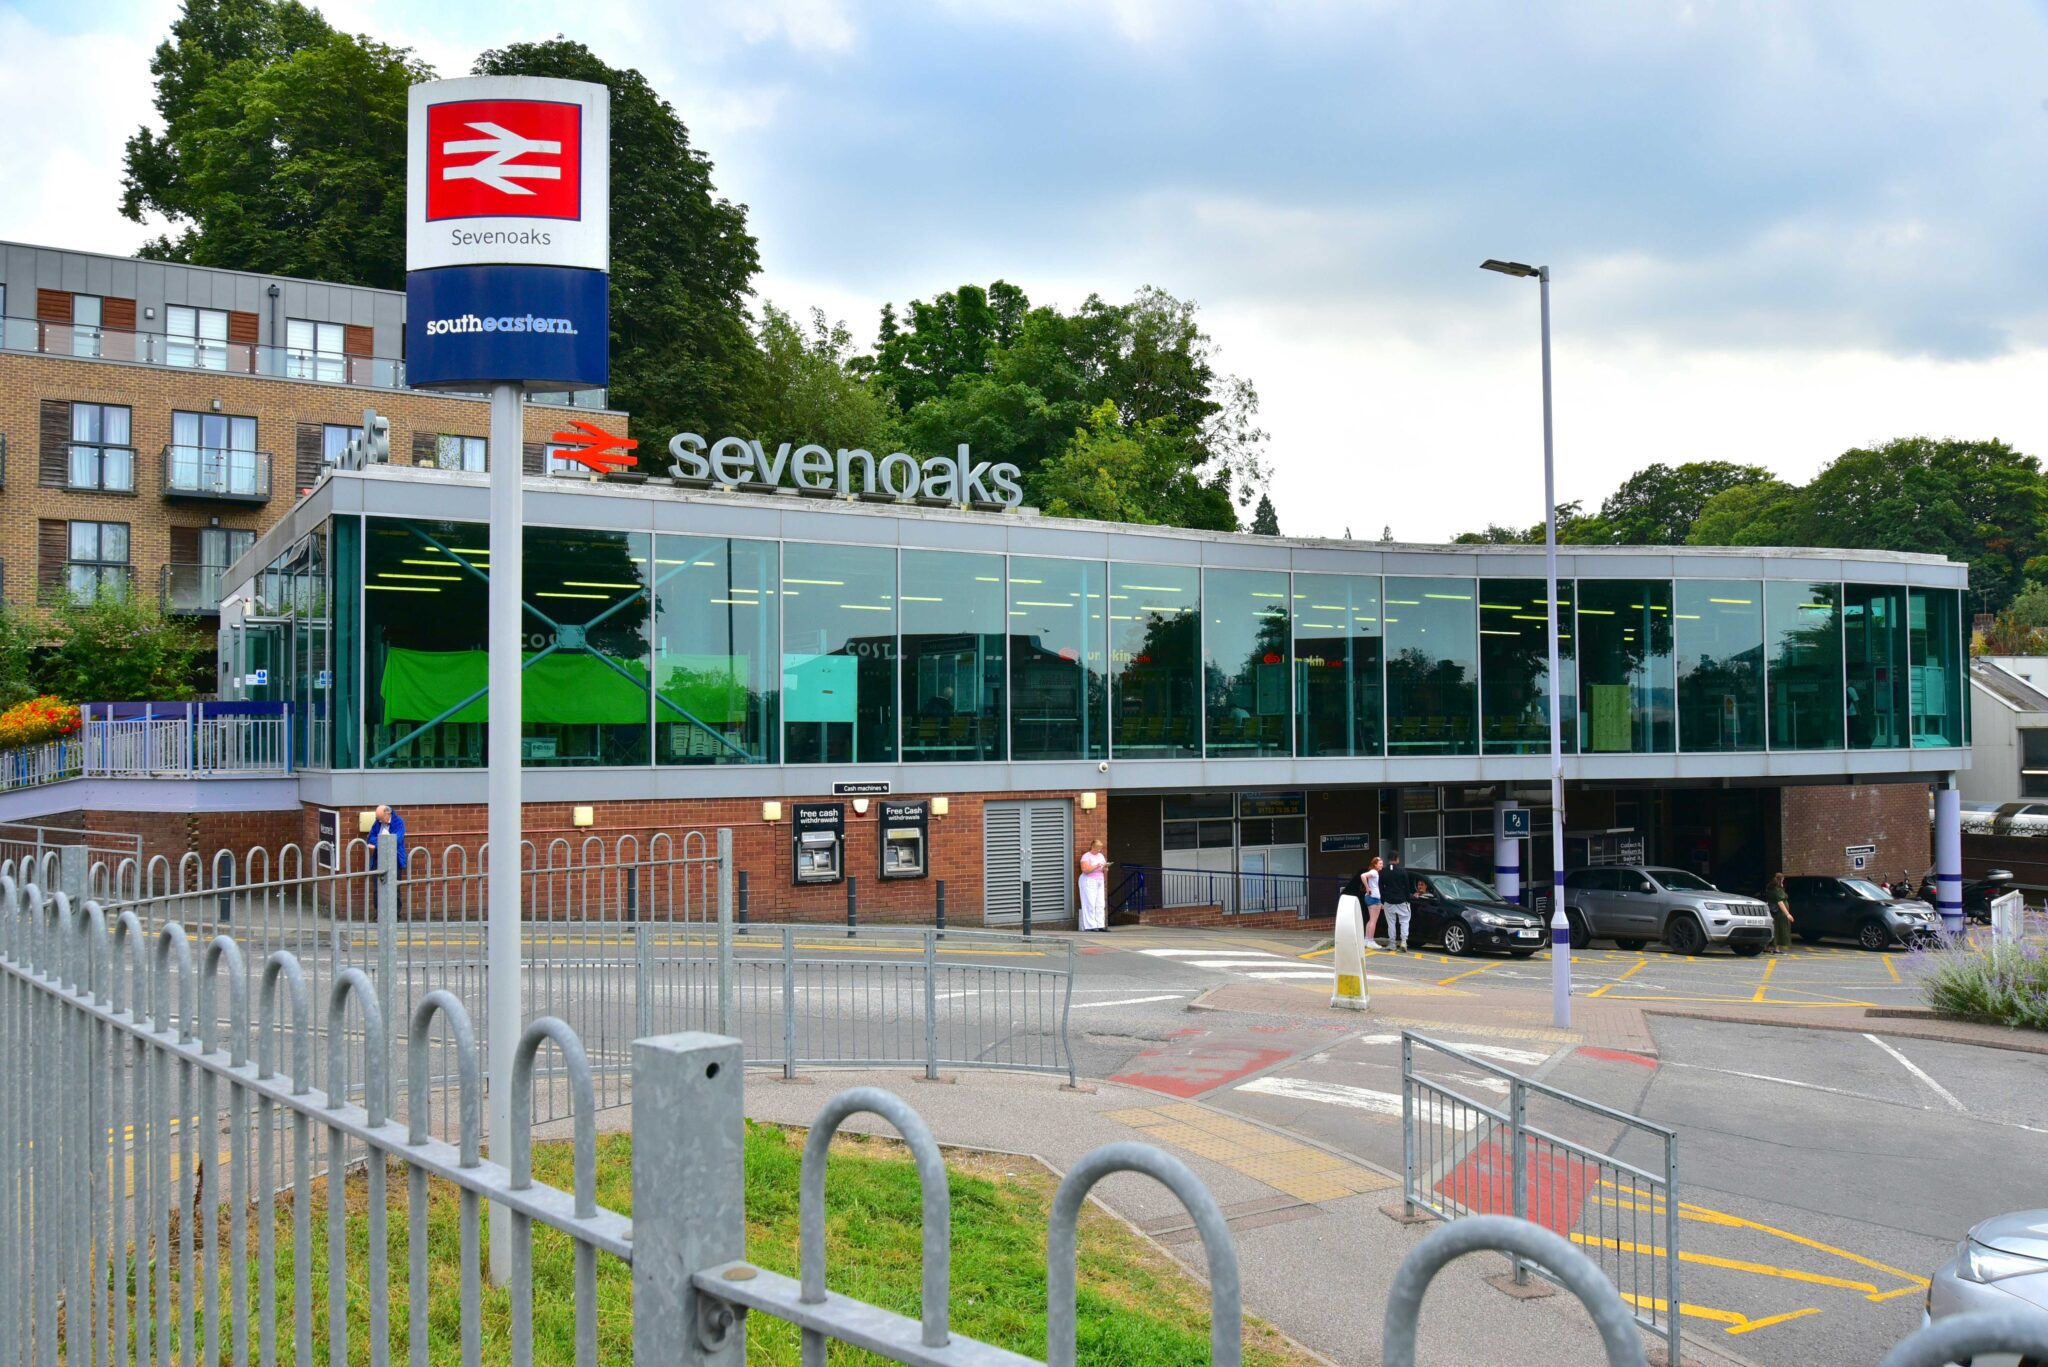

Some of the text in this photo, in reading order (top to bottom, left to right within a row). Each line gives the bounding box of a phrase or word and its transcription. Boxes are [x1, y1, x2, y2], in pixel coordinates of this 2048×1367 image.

[451, 228, 552, 246] Sevenoaks
[426, 313, 579, 336] southeastern.
[667, 432, 1024, 508] sevenoaks
[800, 808, 839, 818] free cash
[886, 806, 923, 815] Free Cash
